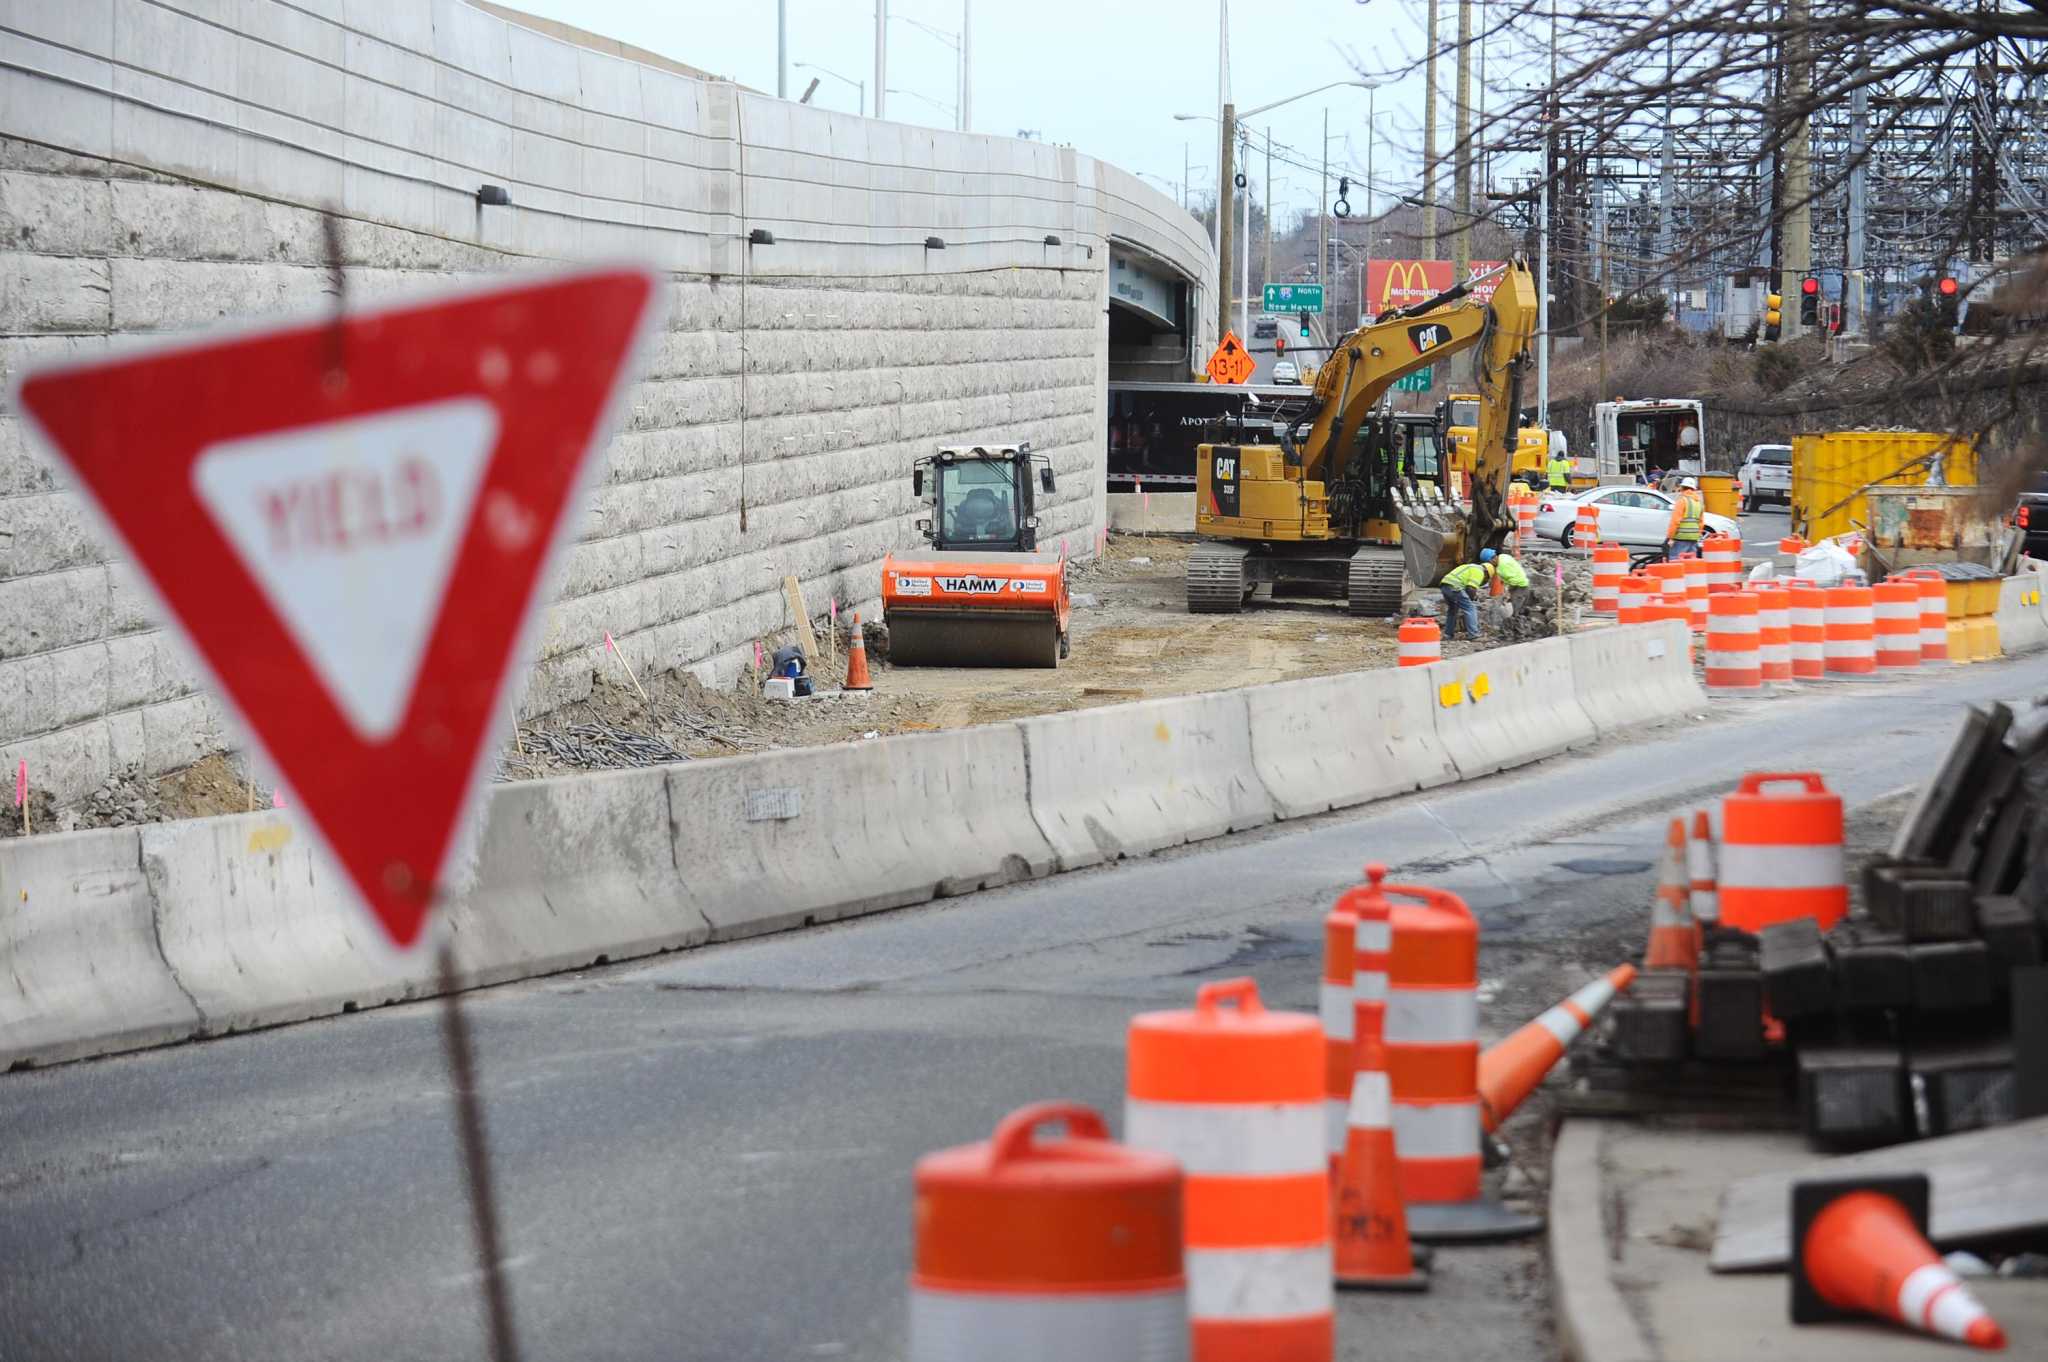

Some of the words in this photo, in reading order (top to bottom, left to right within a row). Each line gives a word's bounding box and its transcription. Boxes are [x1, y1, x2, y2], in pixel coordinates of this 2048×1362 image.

[1297, 287, 1320, 296] NORTH
[1268, 303, 1287, 312] New
[1290, 303, 1318, 312] Haven
[1419, 325, 1438, 352] CAT
[1180, 416, 1209, 426] APOT
[1216, 457, 1236, 480] CAT
[254, 453, 444, 563] YIELD
[946, 579, 997, 592] HAMM
